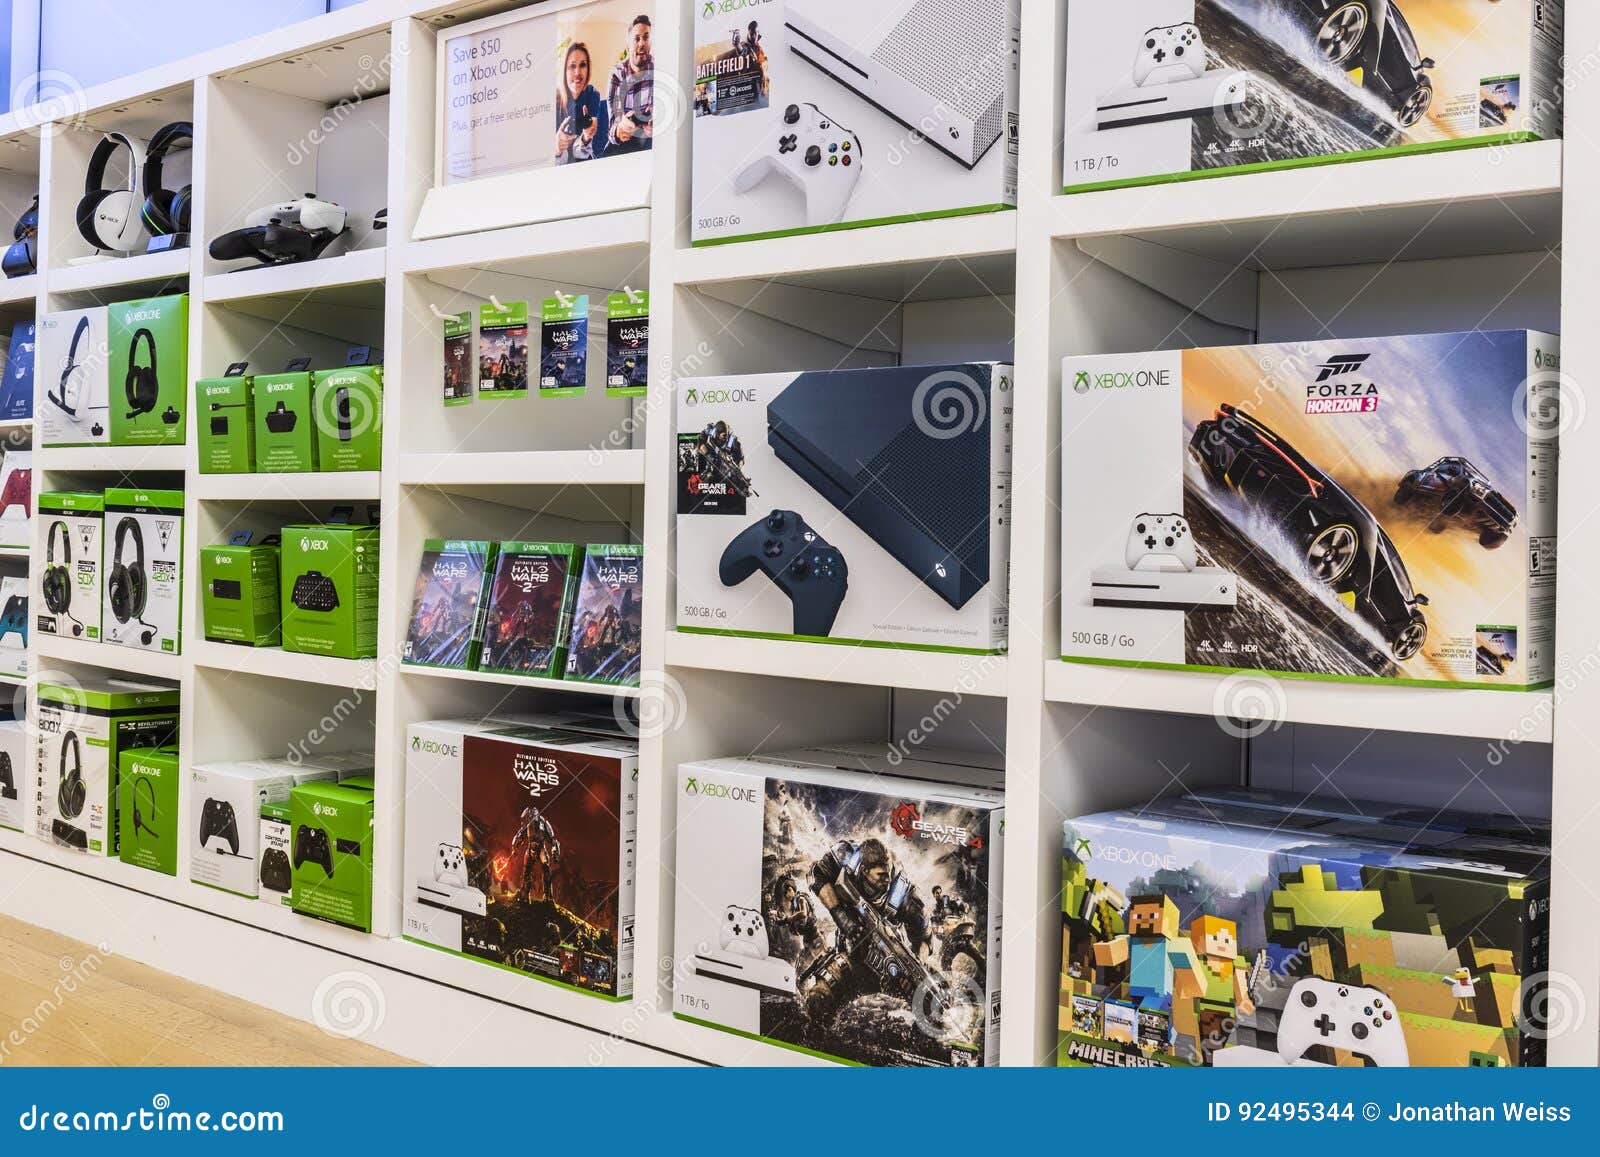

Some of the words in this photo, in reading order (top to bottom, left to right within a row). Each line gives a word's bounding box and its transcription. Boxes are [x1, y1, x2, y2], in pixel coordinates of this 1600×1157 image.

[452, 46, 478, 64] Save
[481, 38, 500, 58] $50
[452, 74, 467, 86] on
[470, 65, 497, 82] Xbox
[500, 58, 523, 75] One
[525, 53, 532, 70] S
[696, 56, 743, 79] BATTLEFIELD
[744, 54, 750, 69] 1
[452, 87, 498, 109] consoles
[470, 117, 482, 130] get
[490, 111, 504, 124] free
[505, 108, 527, 122] select
[528, 102, 552, 119] game
[1248, 138, 1265, 148] HDR
[1074, 160, 1079, 172] 1
[1082, 158, 1095, 171] TB
[1097, 157, 1103, 170] /
[1106, 155, 1119, 168] To
[698, 217, 713, 229] 500
[713, 215, 725, 228] GB
[730, 214, 741, 226] Go
[631, 340, 639, 349] 2
[1094, 372, 1134, 389] XBOX
[1136, 370, 1170, 387] ONE
[701, 390, 730, 403] XBOX
[732, 389, 756, 403] ONE
[1306, 383, 1379, 398] FORZA
[1306, 398, 1363, 414] HORIZON
[1365, 397, 1376, 412] 3
[310, 539, 329, 551] XBOX
[434, 561, 468, 570] HALO
[512, 566, 549, 574] HALO
[599, 566, 638, 575] HALO
[433, 569, 468, 578] WARS
[511, 572, 549, 582] WARS
[598, 574, 638, 583] WARS
[522, 582, 532, 593] 2
[684, 606, 697, 617] 500
[698, 607, 709, 618] GB
[715, 608, 727, 618] Go
[1072, 632, 1090, 645] 500
[1094, 633, 1108, 646] GB
[1111, 634, 1116, 647] /
[1119, 634, 1135, 647] Go
[1200, 639, 1211, 648] 4K
[1222, 641, 1233, 649] 4K
[1241, 644, 1258, 653] HDR
[420, 739, 441, 755] XBOX
[441, 743, 458, 758] ONE
[517, 753, 536, 762] ULTIMATE
[537, 755, 556, 763] EDITION
[514, 759, 558, 774] HALO
[513, 768, 559, 786] WARS
[530, 783, 541, 797] 2
[700, 782, 730, 798] XBOX
[731, 787, 757, 803] ONE
[322, 805, 338, 817] XBOX
[912, 820, 967, 836] GEARS
[931, 834, 968, 848] WAR
[969, 834, 983, 849] 4
[1097, 846, 1141, 866] XBOX
[1142, 852, 1177, 872] ONE
[411, 919, 418, 928] TB
[422, 923, 429, 933] To
[680, 994, 685, 1003] 1
[686, 995, 695, 1007] TB
[700, 999, 710, 1011] To
